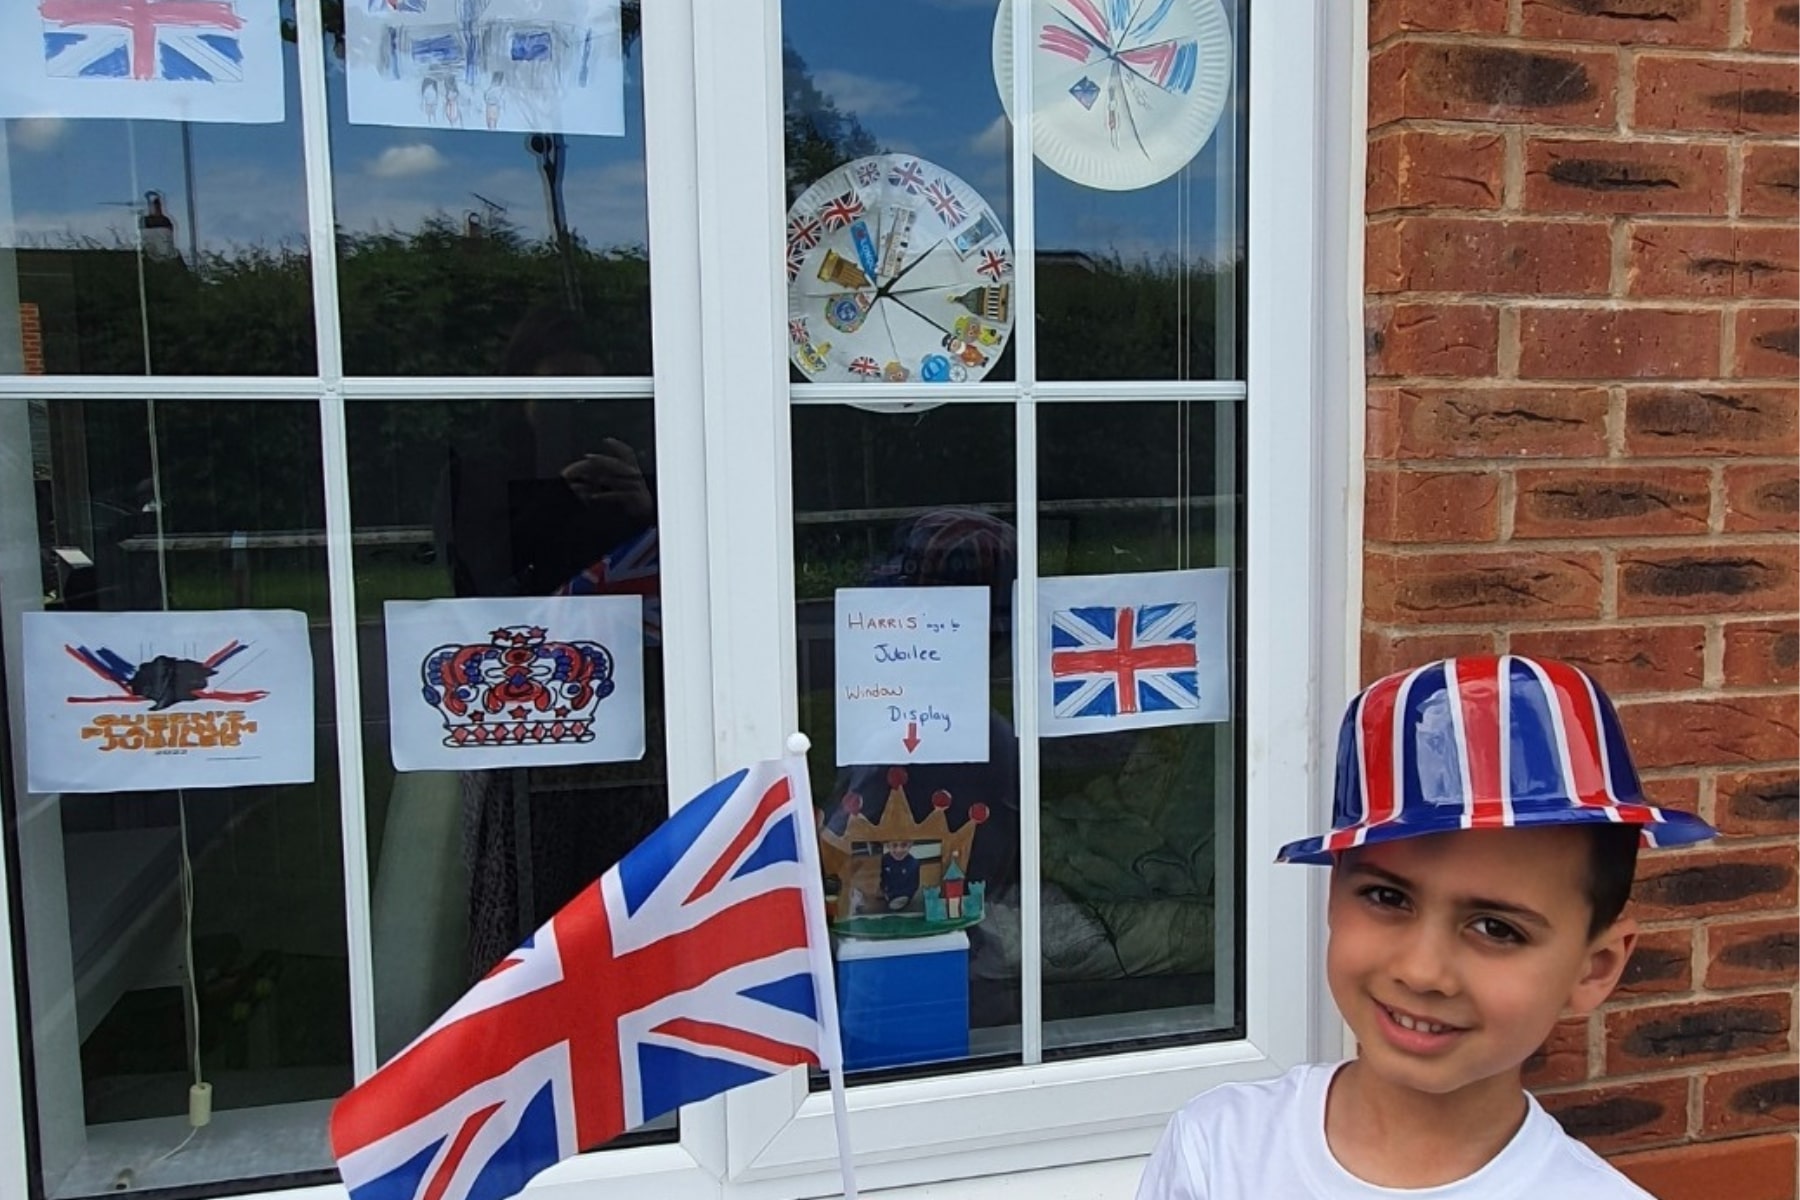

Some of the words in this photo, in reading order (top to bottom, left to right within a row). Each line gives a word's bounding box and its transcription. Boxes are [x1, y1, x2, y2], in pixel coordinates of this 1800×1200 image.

[873, 643, 942, 663] Jubilee
[845, 683, 903, 700] Window
[887, 705, 951, 732] Display
